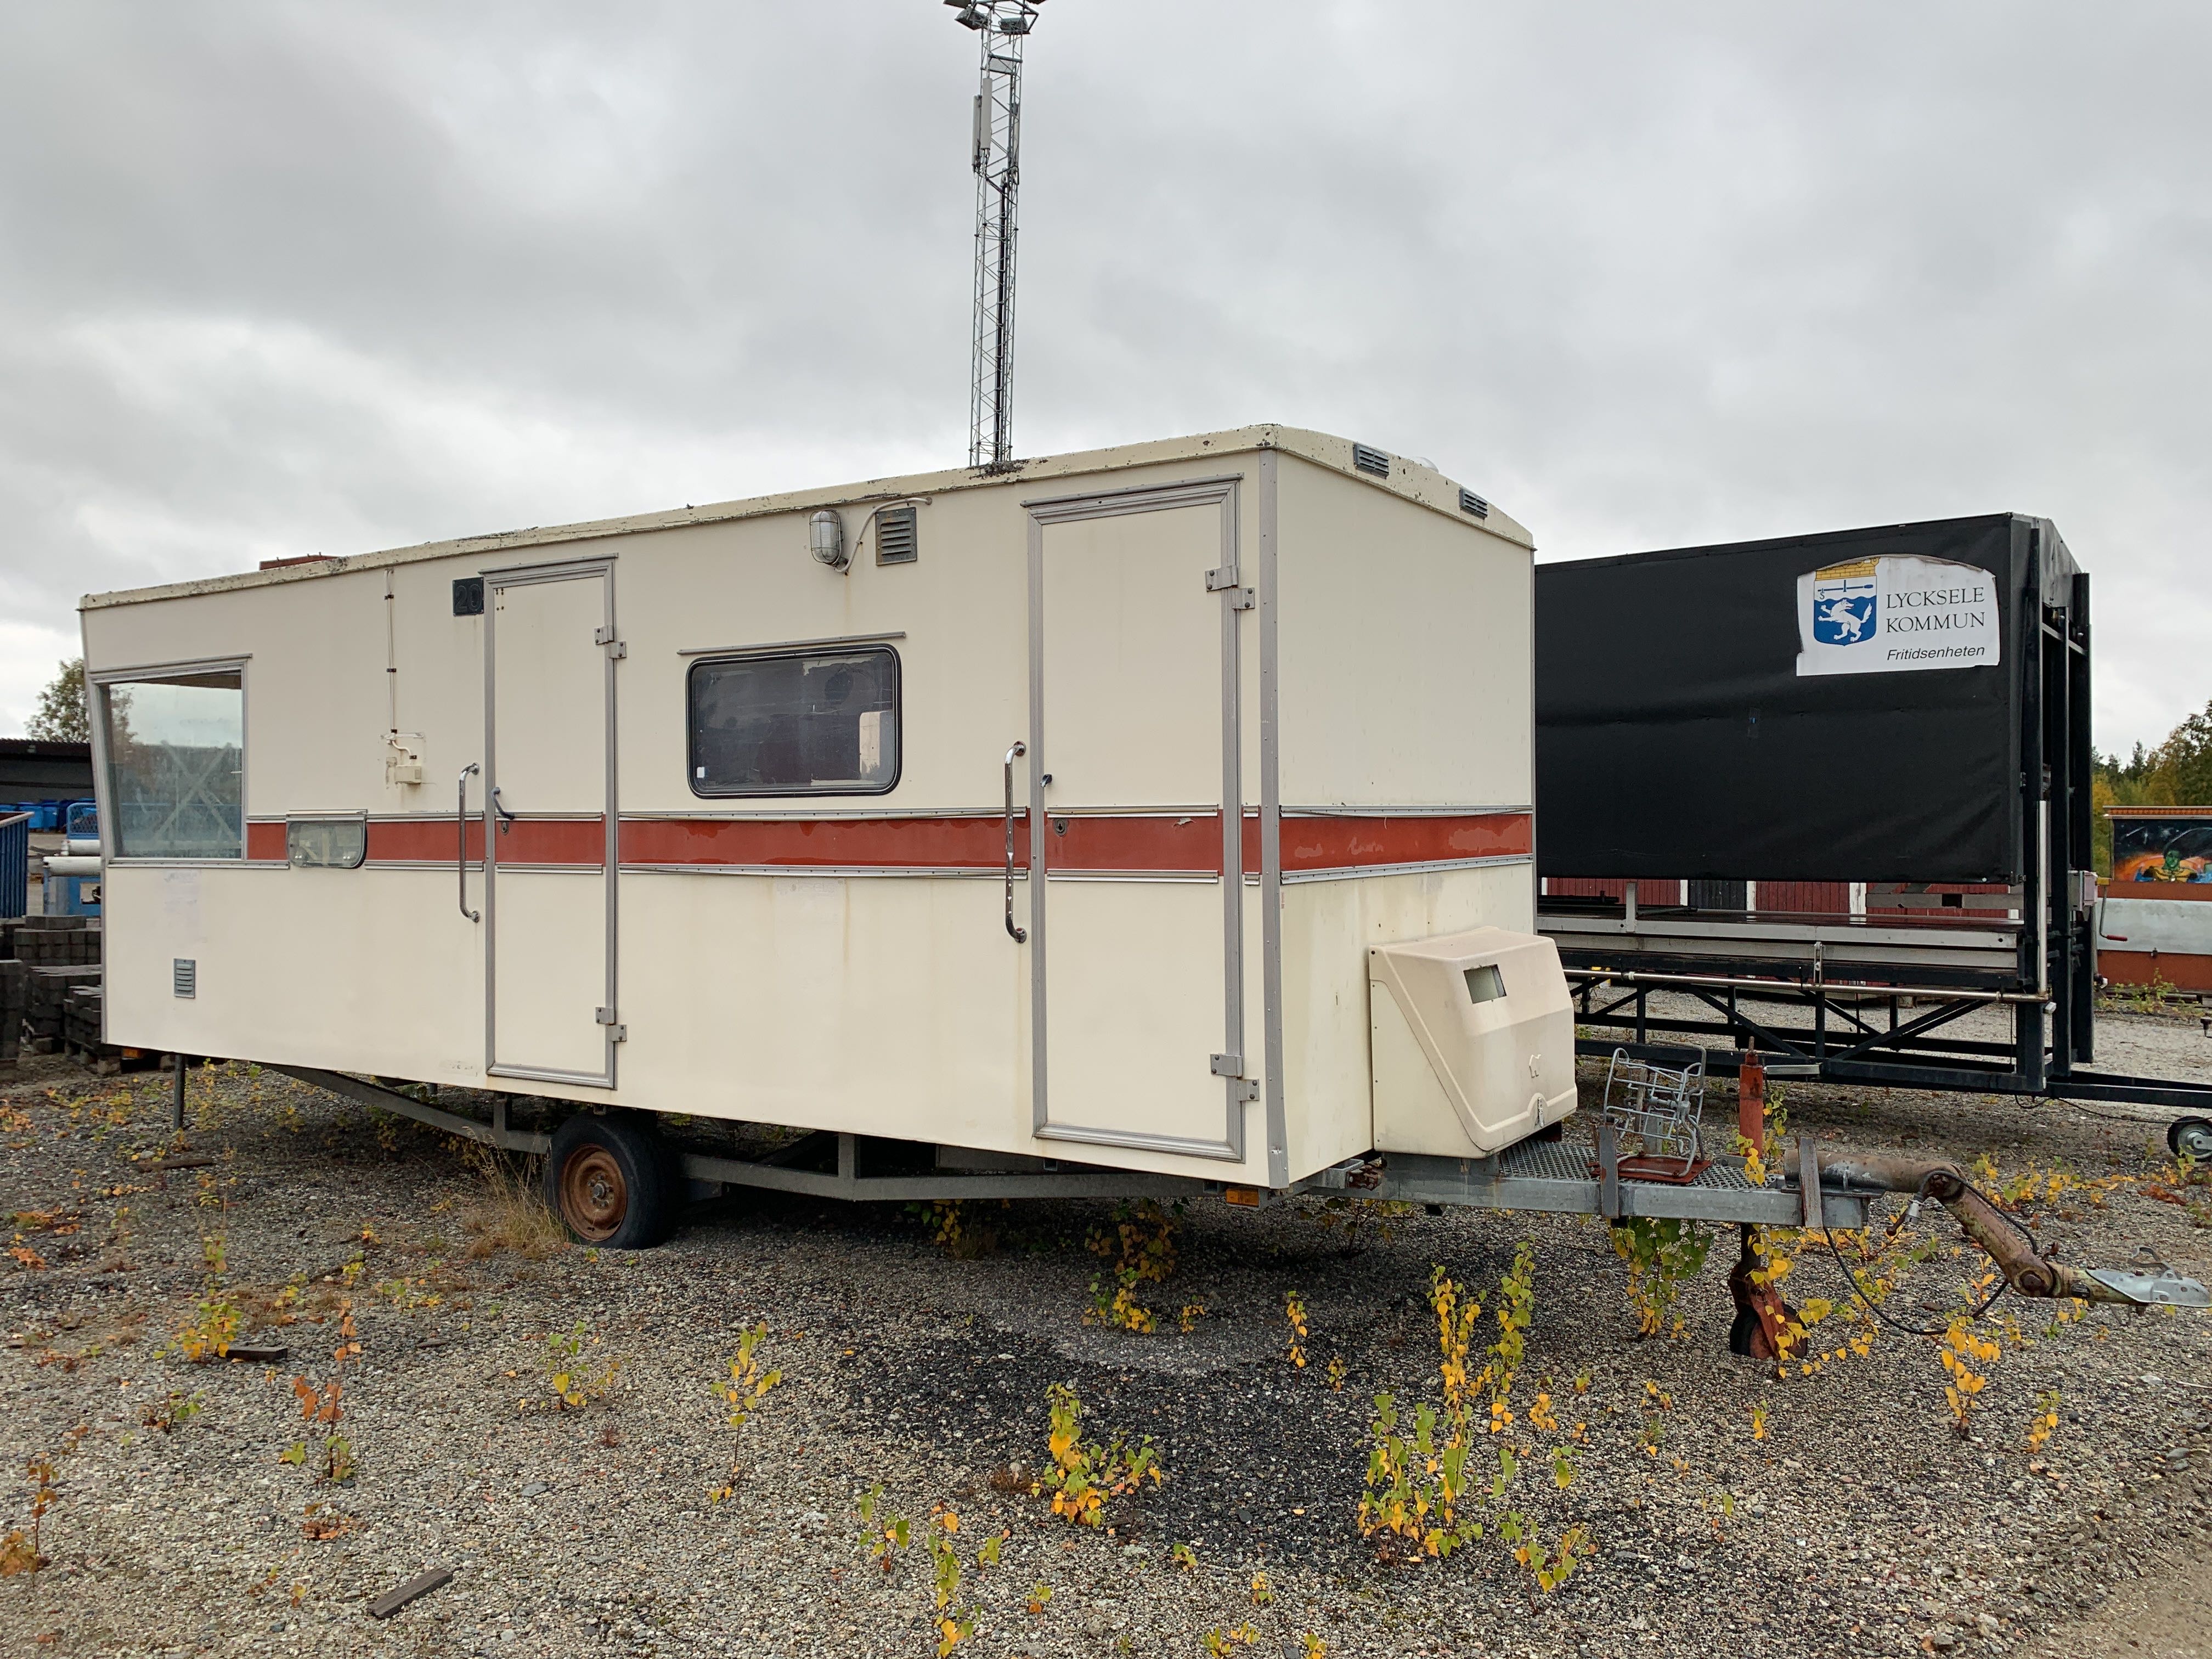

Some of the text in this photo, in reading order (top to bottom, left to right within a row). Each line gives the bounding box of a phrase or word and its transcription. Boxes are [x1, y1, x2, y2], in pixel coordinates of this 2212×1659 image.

[455, 584, 482, 613] 20
[1886, 586, 1985, 609] LYCKSELE
[1886, 612, 1985, 633] KOMMUN
[1887, 646, 1985, 661] Fritidsenheten
